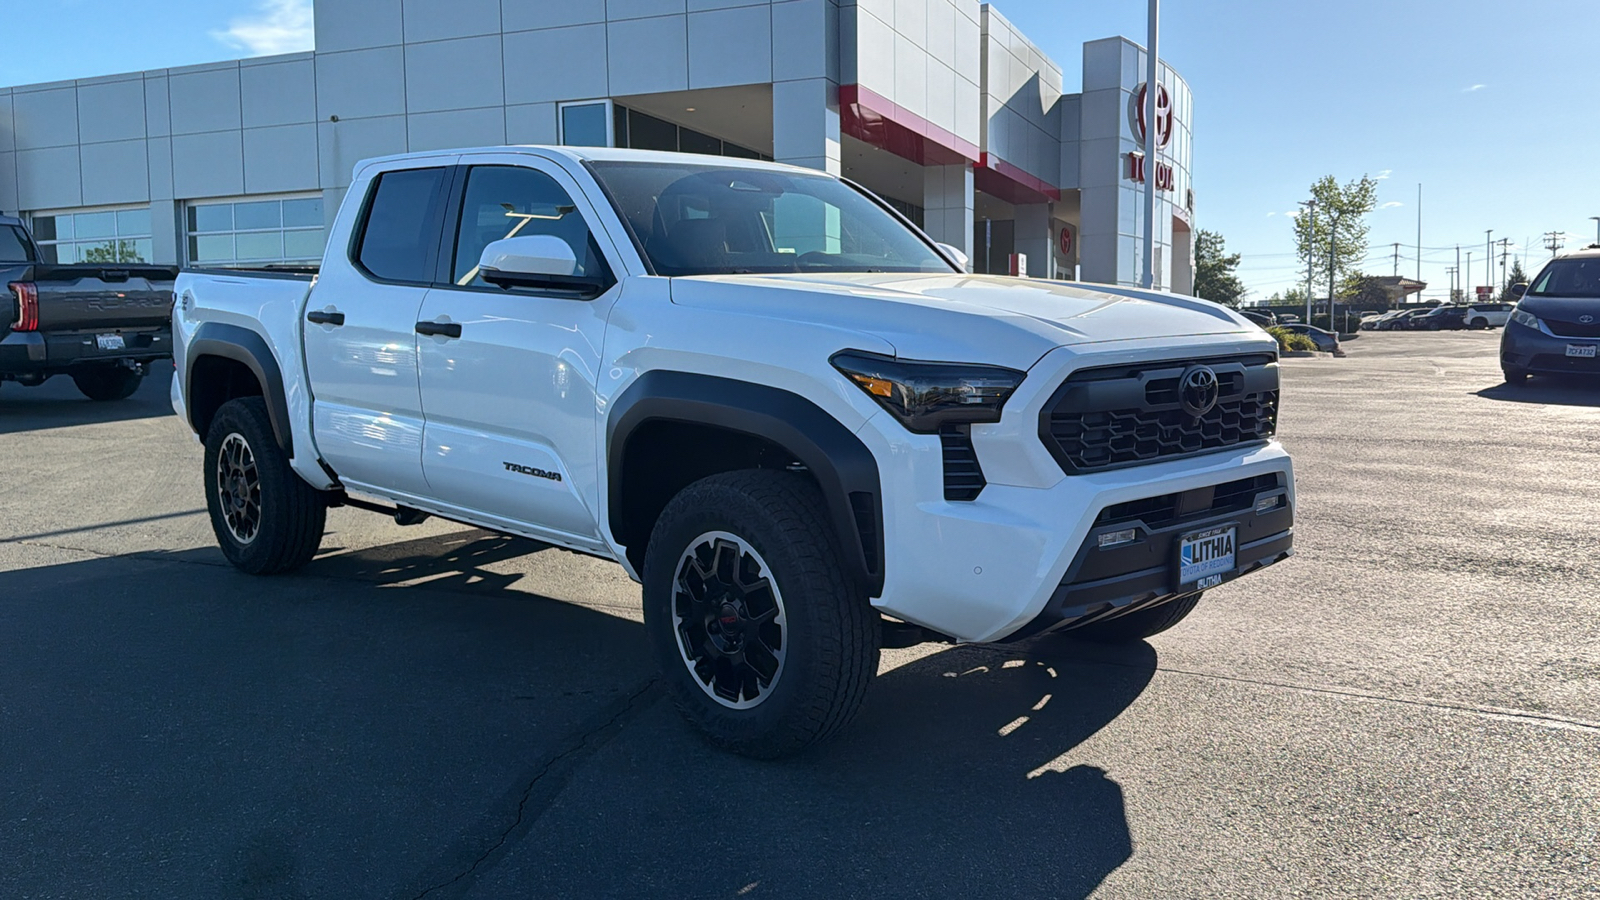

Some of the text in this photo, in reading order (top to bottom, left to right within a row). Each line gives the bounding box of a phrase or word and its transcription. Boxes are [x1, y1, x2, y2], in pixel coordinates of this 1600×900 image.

[503, 461, 562, 482] TACOMA
[1192, 535, 1233, 564] LITHIA
[1201, 562, 1209, 571] OF
[1209, 556, 1232, 568] REDDING
[1203, 574, 1222, 587] LITHIA
